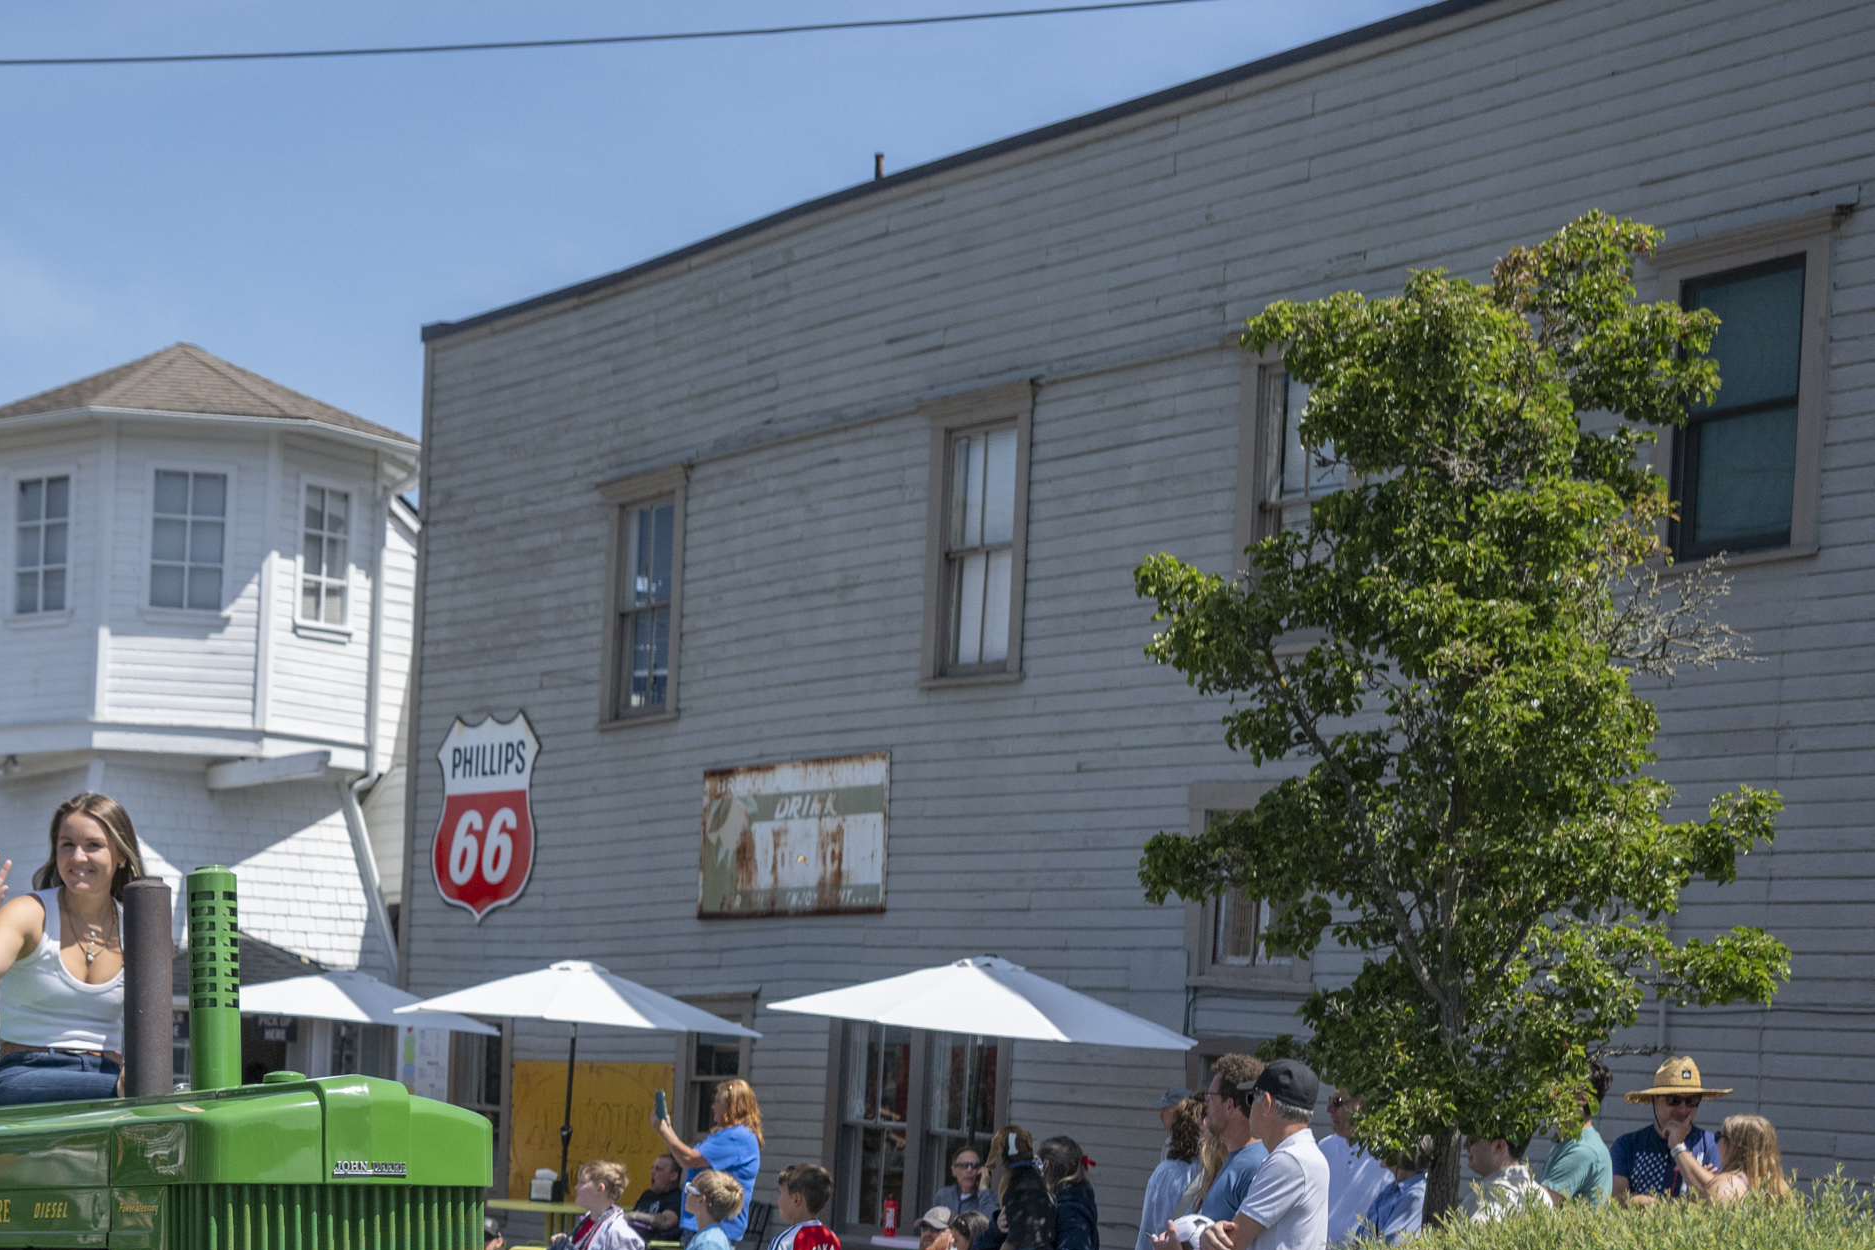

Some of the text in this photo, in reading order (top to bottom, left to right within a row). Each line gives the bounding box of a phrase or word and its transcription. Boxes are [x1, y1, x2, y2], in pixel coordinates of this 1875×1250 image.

[452, 740, 526, 779] PHILLIPS
[774, 792, 837, 821] DRINK
[448, 807, 517, 886] 66
[334, 1160, 407, 1173] JOHN DEERE
[33, 1202, 68, 1219] DIESEL
[118, 1201, 159, 1216] Power Steering
